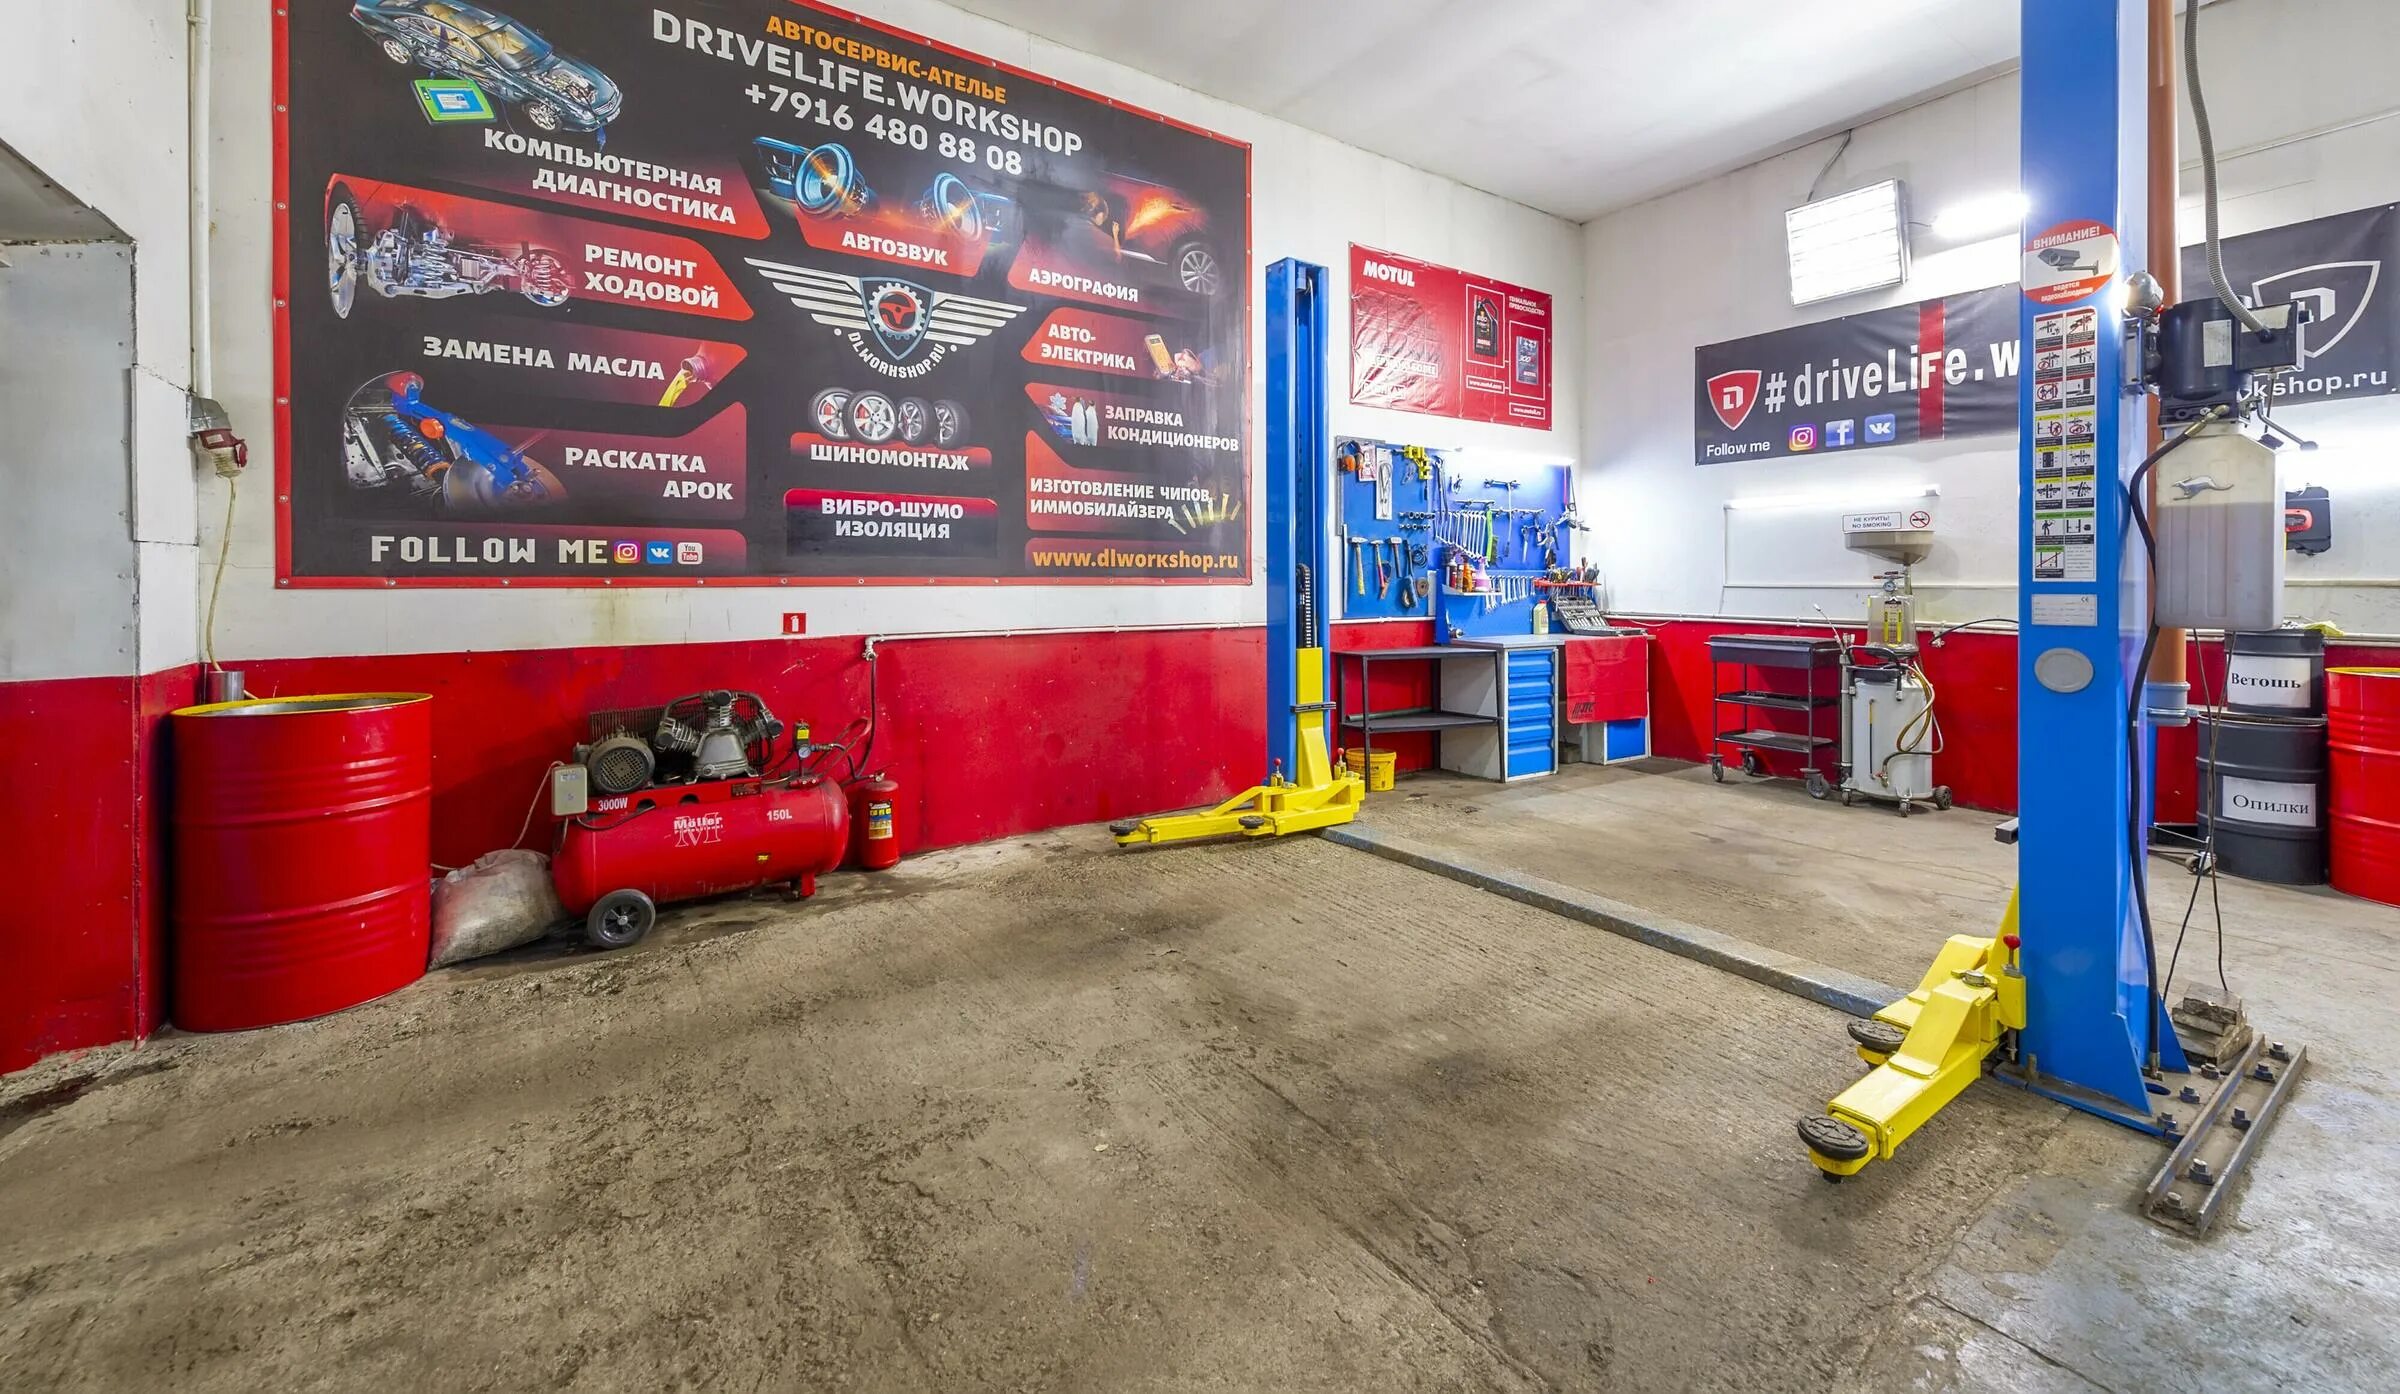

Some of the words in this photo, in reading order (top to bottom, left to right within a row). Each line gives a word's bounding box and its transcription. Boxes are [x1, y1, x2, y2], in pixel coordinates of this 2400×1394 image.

[765, 15, 1007, 104] АВТОСЕРВИС-АТЕЛЬЕ
[653, 9, 1083, 157] DRIVELIFE.WORKSHOP
[744, 83, 854, 131] +7916
[865, 110, 928, 151] 480
[938, 131, 976, 164] 88
[986, 144, 1022, 175] 08
[484, 128, 723, 196] КОМПЬЮТЕРНАЯ
[532, 168, 737, 225] ДИАГНОСТИКА
[842, 231, 949, 266] АВТОЗВУК
[2033, 226, 2100, 250] ВНИМАНИЕ!
[585, 244, 697, 279] РЕМОНТ
[1362, 260, 1415, 287] MOTUL
[584, 271, 719, 309] ХОДОВОЙ
[1029, 268, 1139, 303] АЭРОГРАФИЯ
[1048, 323, 1096, 343] АВТО-
[423, 336, 554, 369] ЗАМЕНА
[567, 352, 665, 381] МАСЛА
[1041, 343, 1136, 371] ЭЛЕКТРИКА
[1105, 405, 1184, 427] ЗАПРАВКА
[1107, 425, 1239, 452] КОНДИЦИОНЕРОВ
[1706, 442, 1747, 457] Follow
[1750, 440, 1771, 453] me
[565, 447, 707, 473] РАСКАТКА
[810, 444, 970, 471] ШИНОМОНТАЖ
[663, 480, 733, 500] АРОК
[1030, 478, 1155, 499] ИЗГОТОВЛЕНИЕ
[821, 498, 964, 519] ВИБРО-ШУМО
[1030, 499, 1174, 520] ИММОБИЛАЙЗЕРА
[835, 520, 950, 541] ИЗОЛЯЦИЯ
[371, 535, 536, 564] FOLLOW
[559, 539, 608, 564] ME
[1032, 548, 1239, 573] www.dlworkshop.ru
[2231, 672, 2302, 690] Ветошь
[598, 797, 629, 811] 3000W
[767, 809, 792, 821] 150L
[2232, 794, 2309, 815] Опилки
